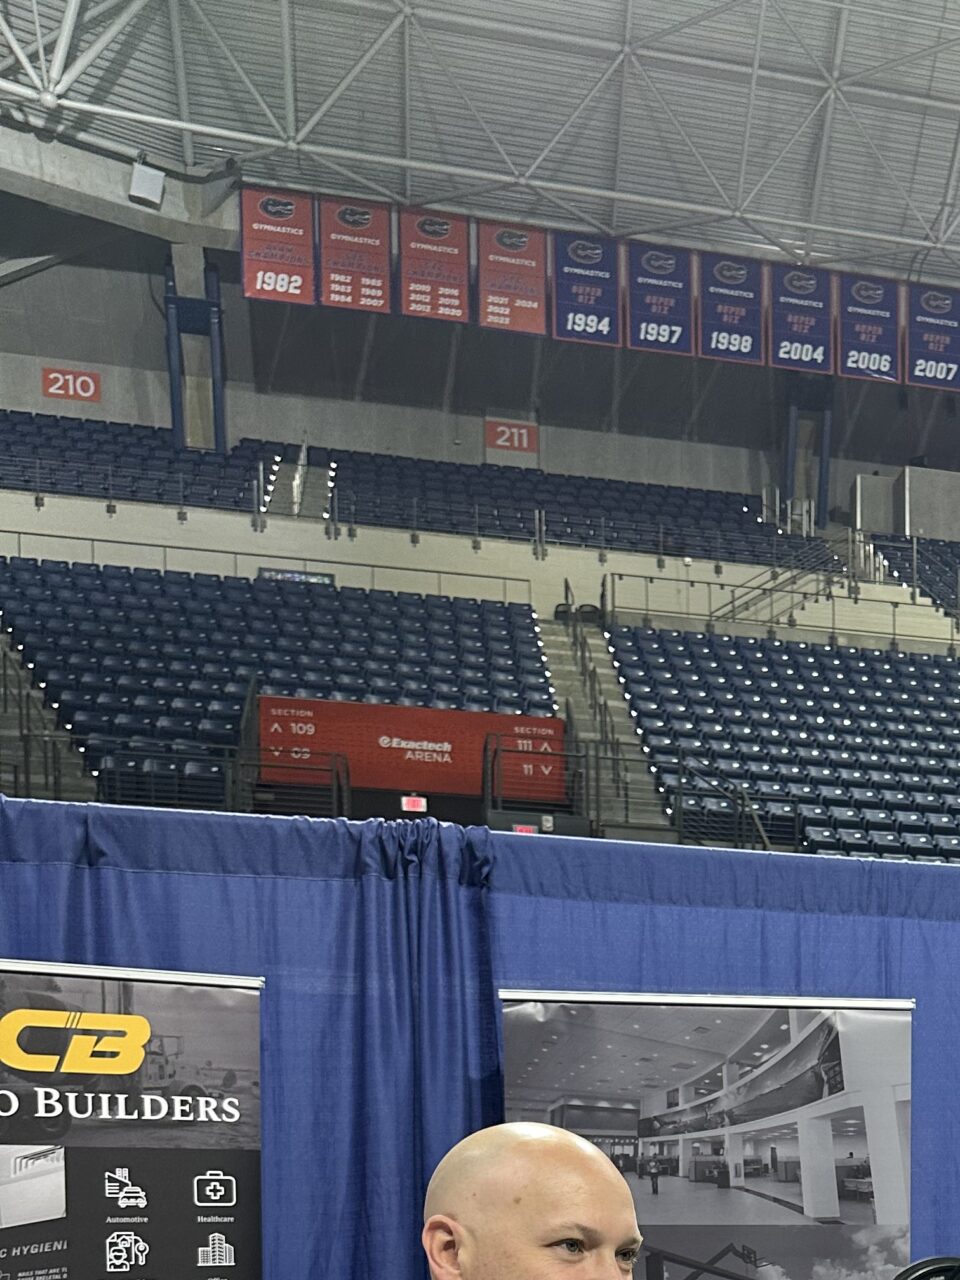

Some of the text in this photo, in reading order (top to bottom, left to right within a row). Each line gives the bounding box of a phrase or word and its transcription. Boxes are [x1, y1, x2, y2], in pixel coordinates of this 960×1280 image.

[252, 223, 304, 235] GYMNASTICS
[330, 233, 380, 246] GYMNASTICS
[410, 242, 458, 255] GYMNASTICS
[489, 255, 537, 267] GYMNASTICS
[256, 271, 303, 294] 1982
[566, 312, 611, 335] 1994
[640, 322, 683, 344] 1997
[711, 331, 753, 353] 1998
[779, 341, 825, 363] 2004
[846, 350, 892, 372] 2006
[914, 359, 959, 381] 2007
[47, 372, 96, 398] 210
[495, 427, 529, 449] 211
[271, 708, 313, 718] SECTION
[290, 723, 315, 735] 109
[513, 726, 554, 736] SECTION
[391, 737, 452, 751] Exactech
[517, 739, 533, 752] 111
[405, 750, 452, 763] ARENA
[33, 1086, 241, 1123] BUILDERS
[197, 1215, 235, 1223] Healthcare
